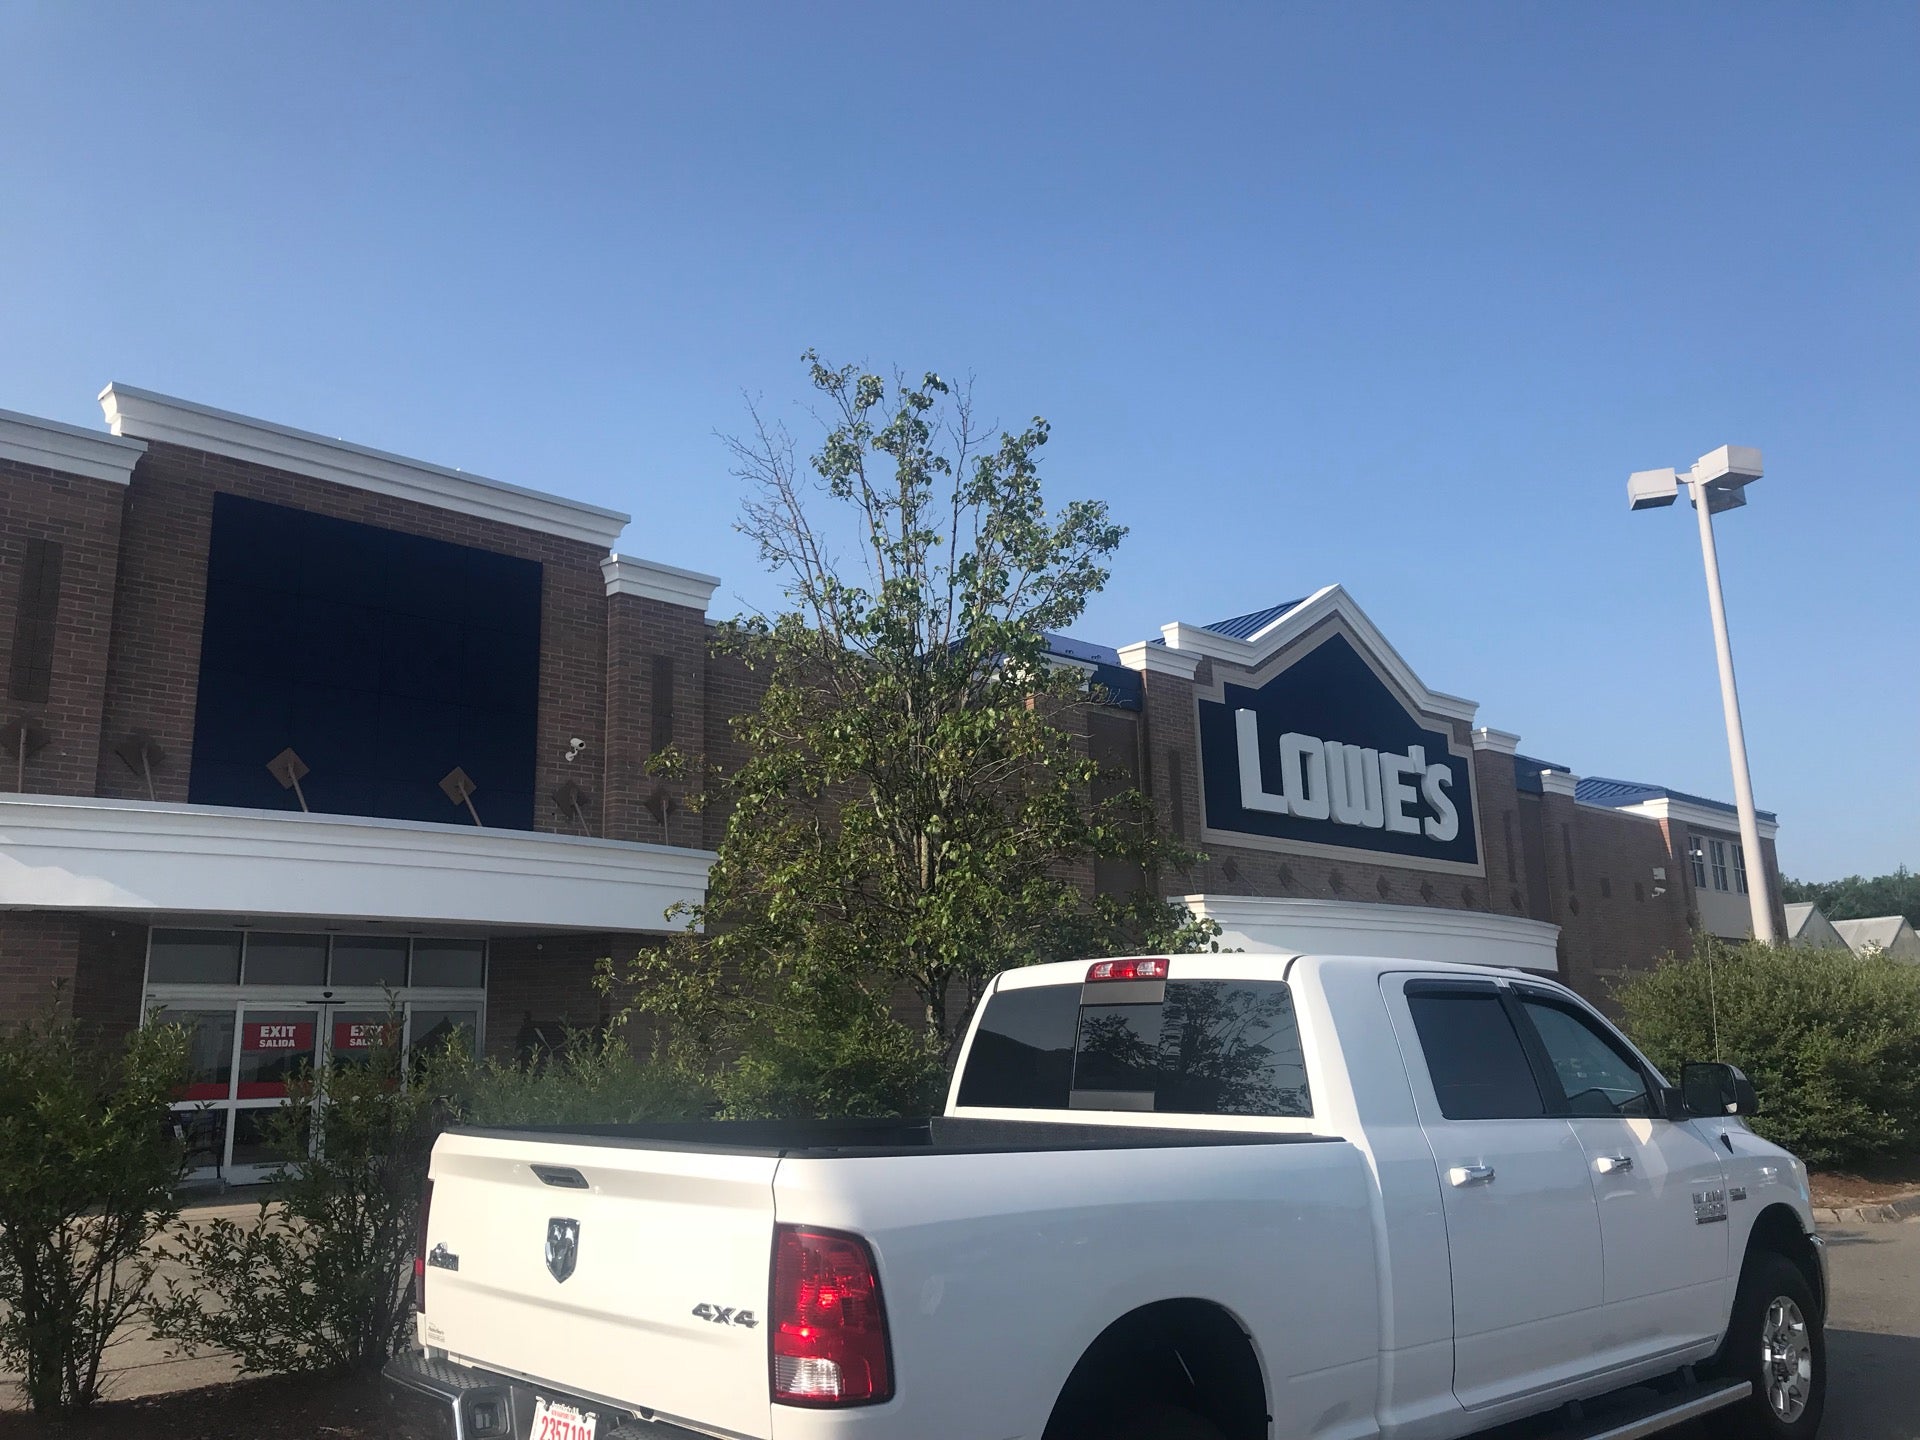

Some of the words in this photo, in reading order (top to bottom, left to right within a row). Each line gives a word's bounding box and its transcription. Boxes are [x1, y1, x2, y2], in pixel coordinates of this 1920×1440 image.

[1235, 709, 1459, 842] LOWE'S
[260, 1025, 296, 1038] EXIT
[259, 1039, 296, 1048] SALIDA
